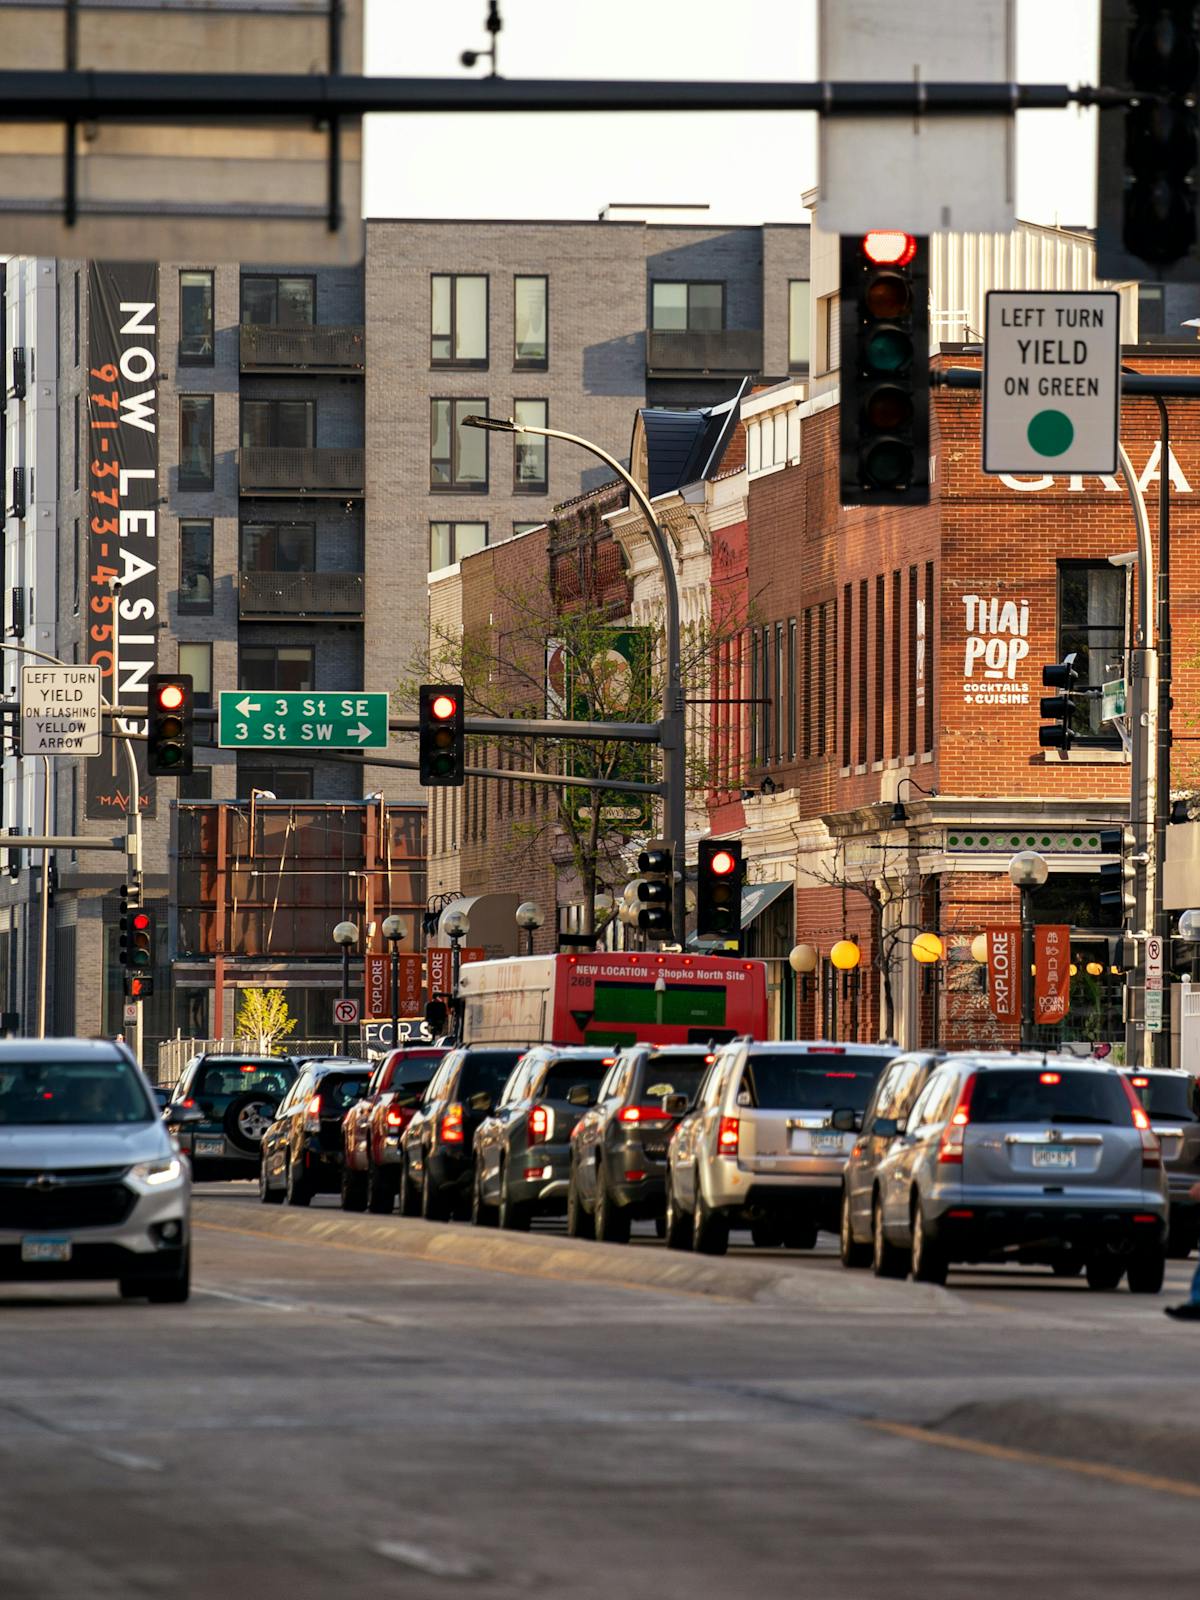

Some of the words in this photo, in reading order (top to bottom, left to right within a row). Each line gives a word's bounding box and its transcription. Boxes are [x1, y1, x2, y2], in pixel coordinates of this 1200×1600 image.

[1001, 308, 1045, 328] LEFT
[1055, 308, 1104, 328] TURN
[1017, 340, 1087, 365] YIELD
[119, 302, 156, 433] NOW
[1004, 377, 1031, 397] ON
[1038, 377, 1099, 397] GREEN
[90, 363, 119, 678] 971-373-4550
[963, 637, 1030, 680] POP
[27, 673, 56, 684] LEFT
[64, 673, 95, 684] TURN
[40, 689, 83, 702] YIELD
[963, 683, 1029, 693] COCKTAILS
[26, 707, 40, 718] ON
[46, 707, 97, 718] FLASHING
[274, 700, 288, 717] 3
[302, 699, 326, 717] St
[340, 700, 369, 717] SE
[36, 722, 86, 733] YELLOW
[235, 723, 249, 740] 3
[263, 723, 287, 740] St
[301, 723, 333, 740] SW
[39, 738, 83, 748] ARROW
[101, 790, 148, 812] MAVN
[432, 952, 443, 1002] PLORE
[576, 965, 598, 975] NEW
[601, 966, 648, 977] LOCATION
[658, 968, 694, 980] Shopko
[697, 970, 723, 980] North
[726, 971, 745, 981] Site
[992, 932, 1009, 1014] EXPLORE
[372, 959, 383, 1014] EXPLORE
[571, 977, 592, 988] 268
[1039, 996, 1064, 1005] DOWN
[1040, 1004, 1064, 1014] TOWN
